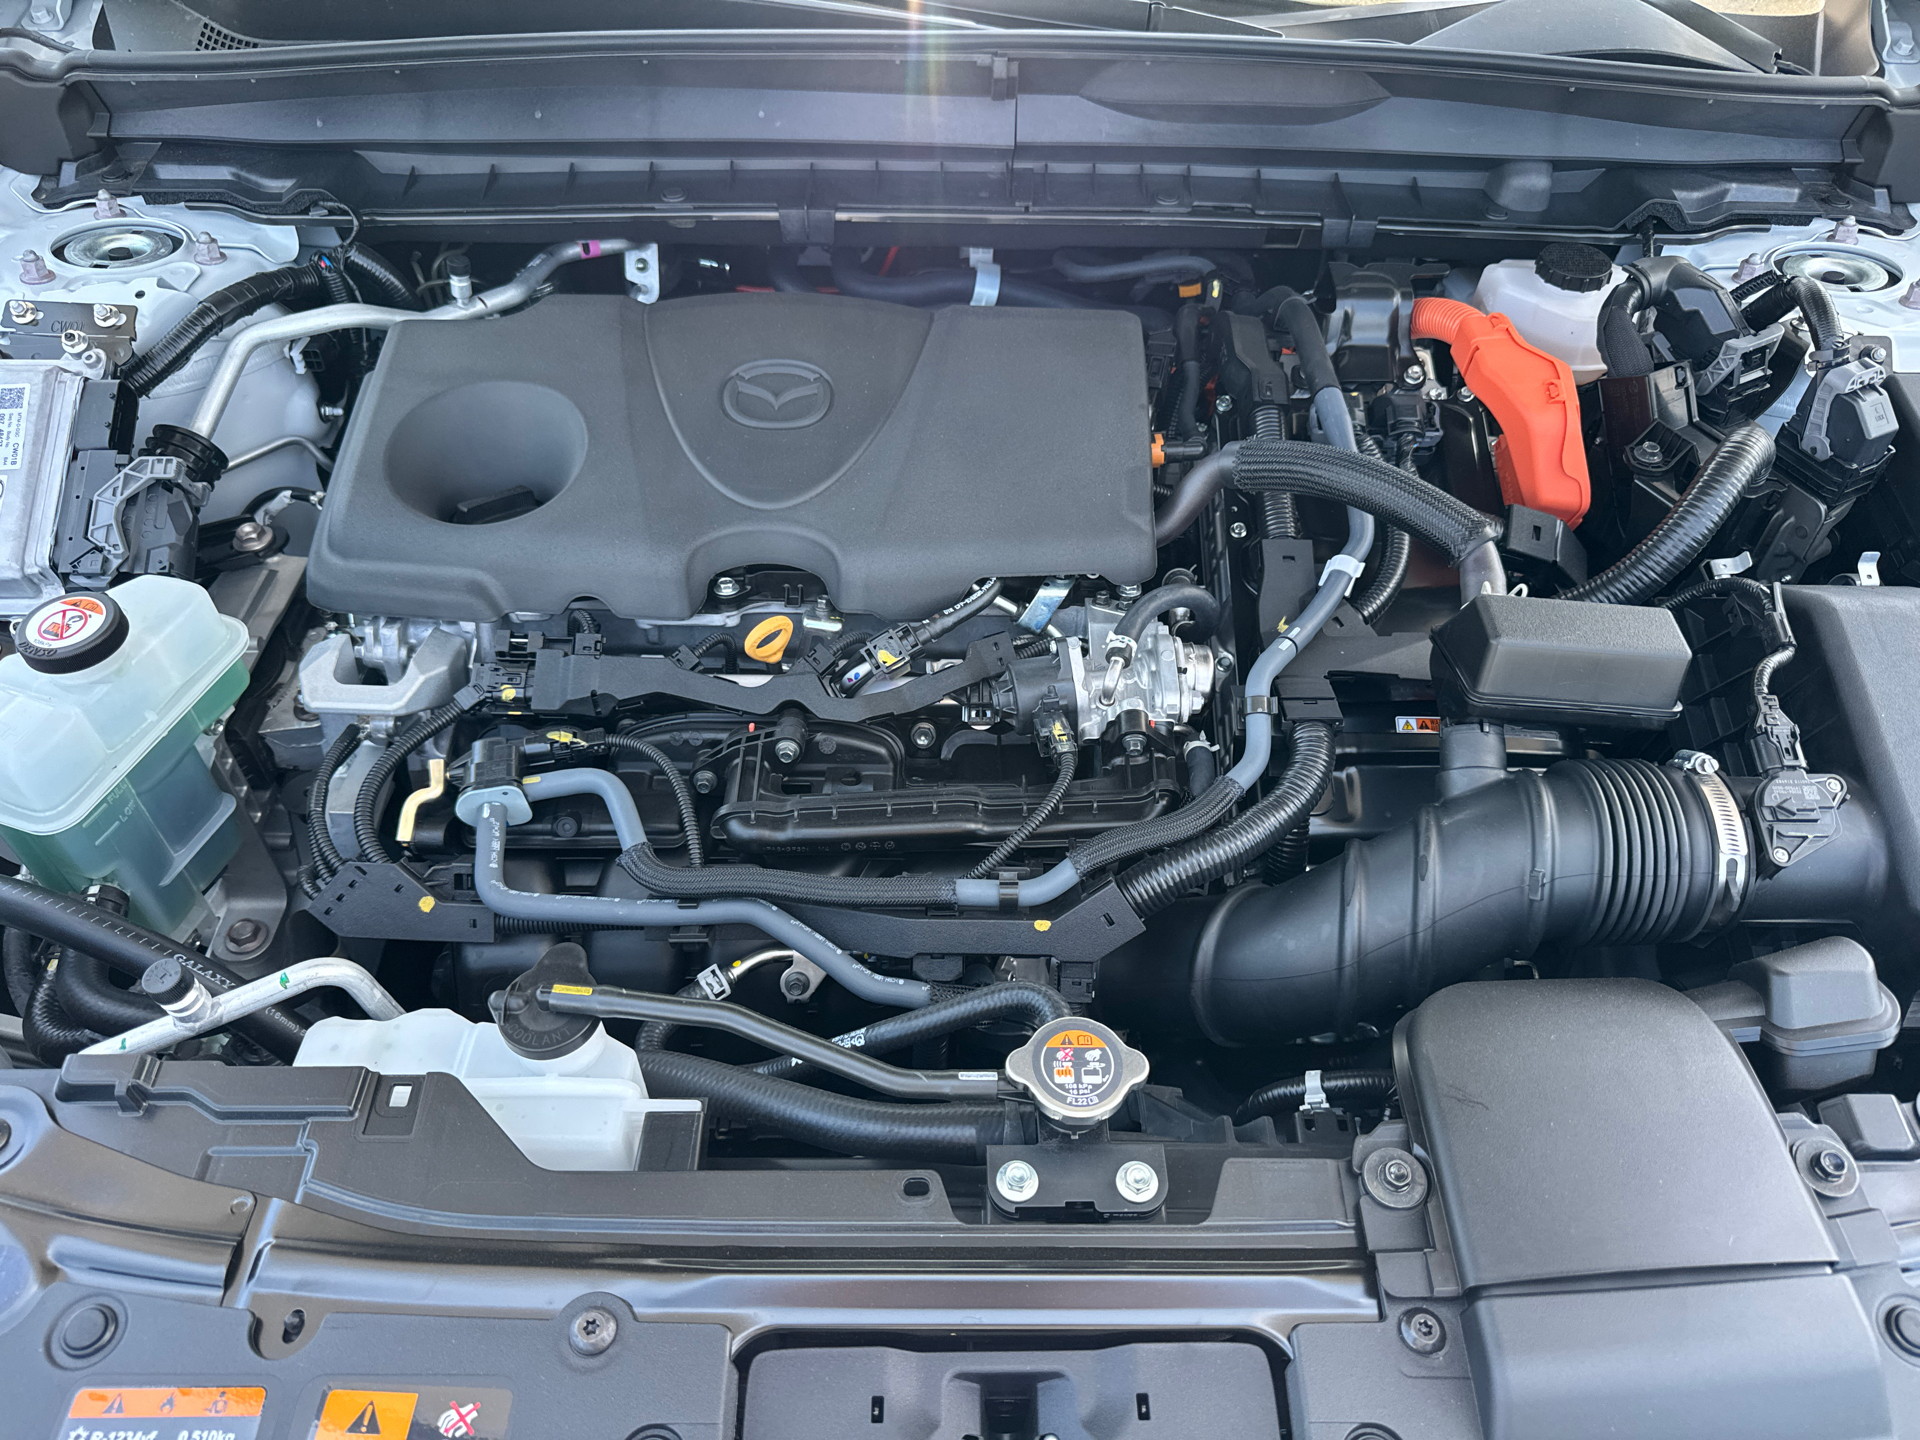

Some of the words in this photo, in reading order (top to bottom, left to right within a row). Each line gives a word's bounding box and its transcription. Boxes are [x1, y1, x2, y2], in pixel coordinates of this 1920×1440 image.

[18, 641, 58, 657] DENSO
[173, 954, 236, 989] GALAXY
[507, 1023, 571, 1046] COOLANT
[1066, 1096, 1088, 1105] FL22
